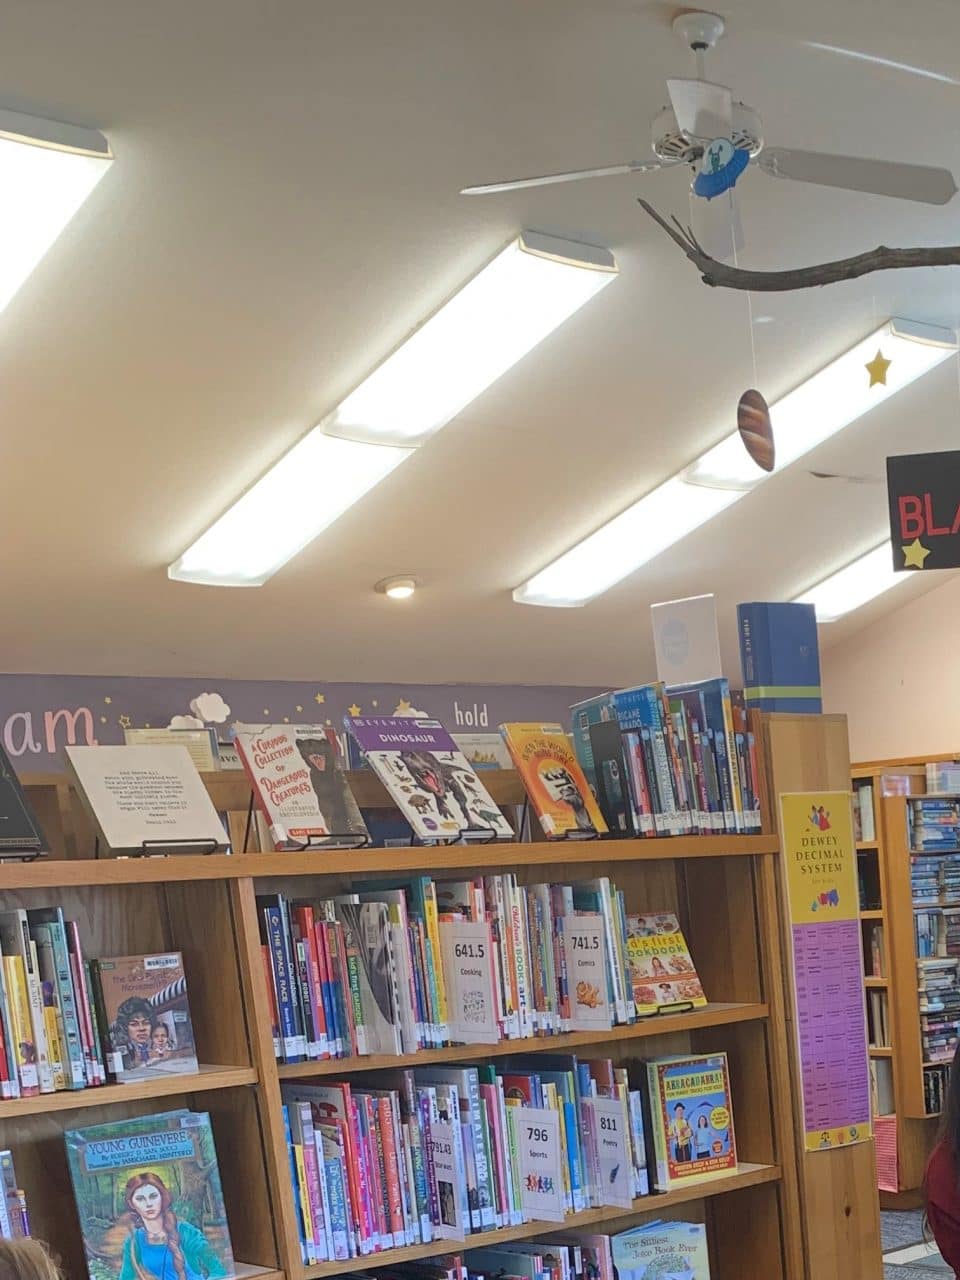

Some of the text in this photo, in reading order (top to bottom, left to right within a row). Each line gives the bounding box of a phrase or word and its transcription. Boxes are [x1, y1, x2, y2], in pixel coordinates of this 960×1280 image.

[454, 702, 488, 726] hold
[379, 734, 436, 743] DINOSAUR
[254, 745, 294, 769] COLLECTION
[260, 769, 308, 792] DANGEROUS
[270, 782, 311, 807] CREATURES
[801, 836, 838, 847] DEWEY
[796, 850, 844, 861] DECIMAL
[800, 863, 842, 874] SYSTEM
[572, 936, 599, 950] 741.5
[653, 936, 681, 946] first
[455, 944, 484, 958] 641.5
[627, 944, 686, 956] ookbook
[272, 929, 289, 1003] THE SPACE RACE
[460, 969, 482, 977] Cooking
[666, 1072, 724, 1092] ABRACADABRA!
[468, 1073, 485, 1142] ULTIMATE
[600, 1117, 617, 1131] 811
[526, 1127, 548, 1142] 796
[89, 1132, 188, 1155] YOUNG GUINEVERE
[603, 1138, 618, 1147] Poetry
[529, 1150, 548, 1159] Sports
[641, 1237, 669, 1246] Silliest
[655, 1246, 676, 1254] Book
[679, 1244, 698, 1253] Ever
